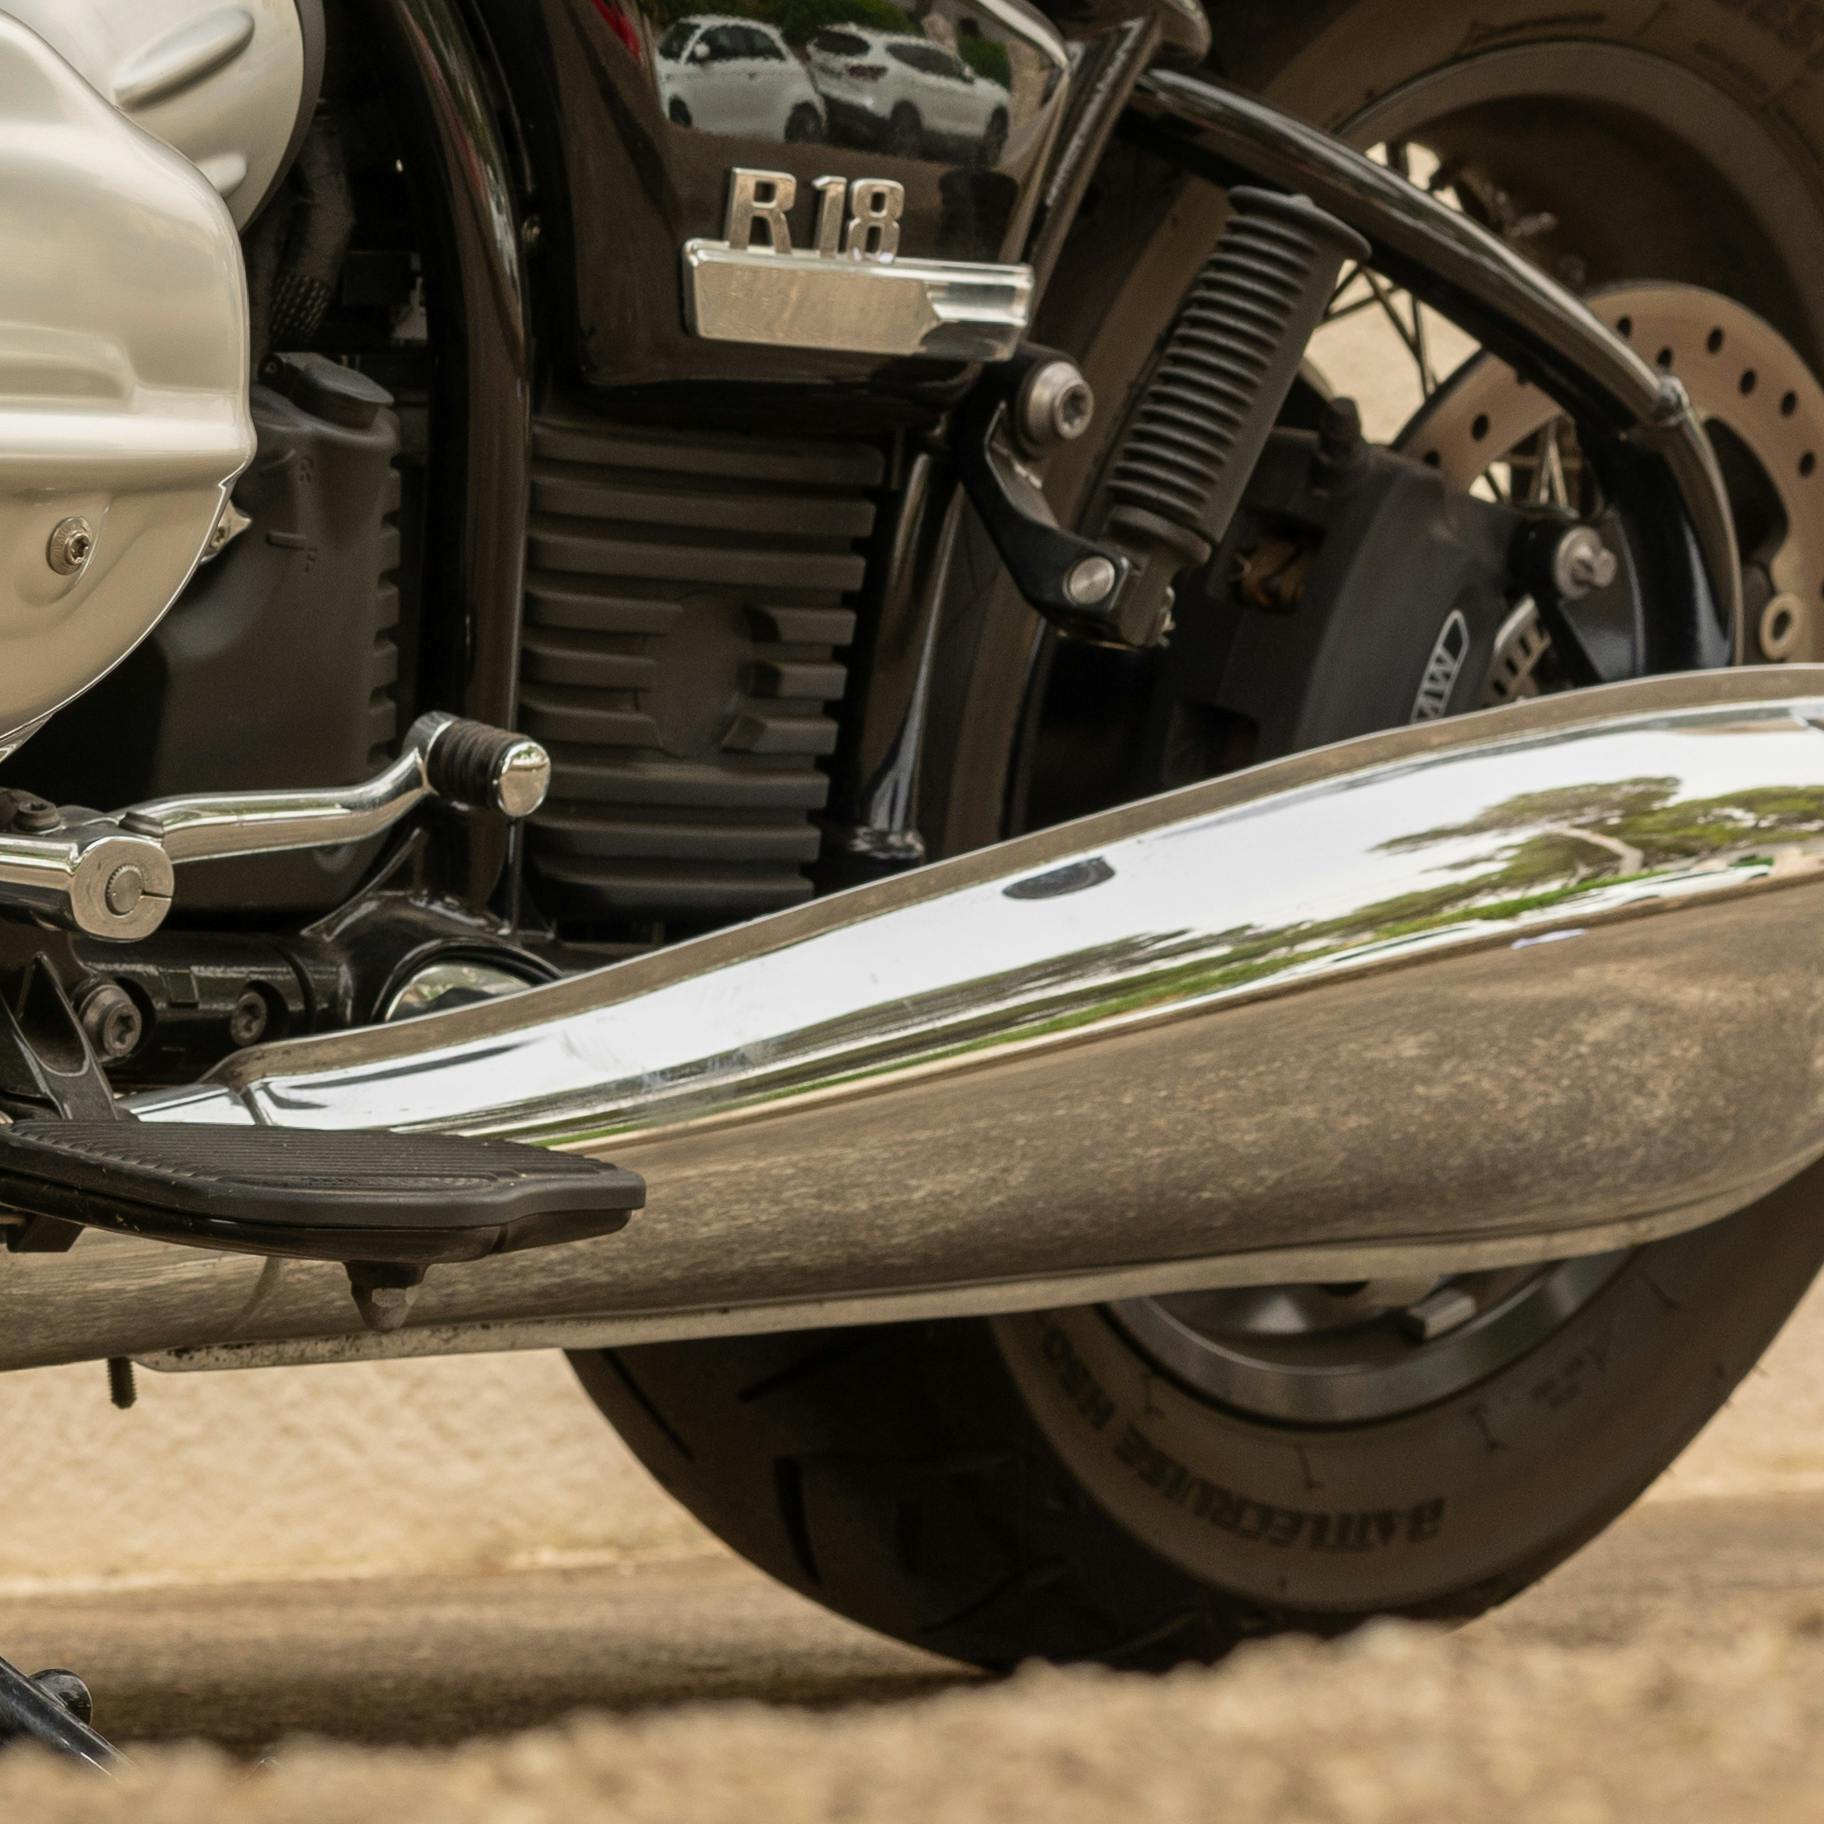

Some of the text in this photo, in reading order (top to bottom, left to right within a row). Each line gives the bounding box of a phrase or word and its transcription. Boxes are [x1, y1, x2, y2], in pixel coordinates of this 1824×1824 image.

[724, 167, 905, 264] R 18
[1111, 1423, 1448, 1555] BATTLECRUISE
